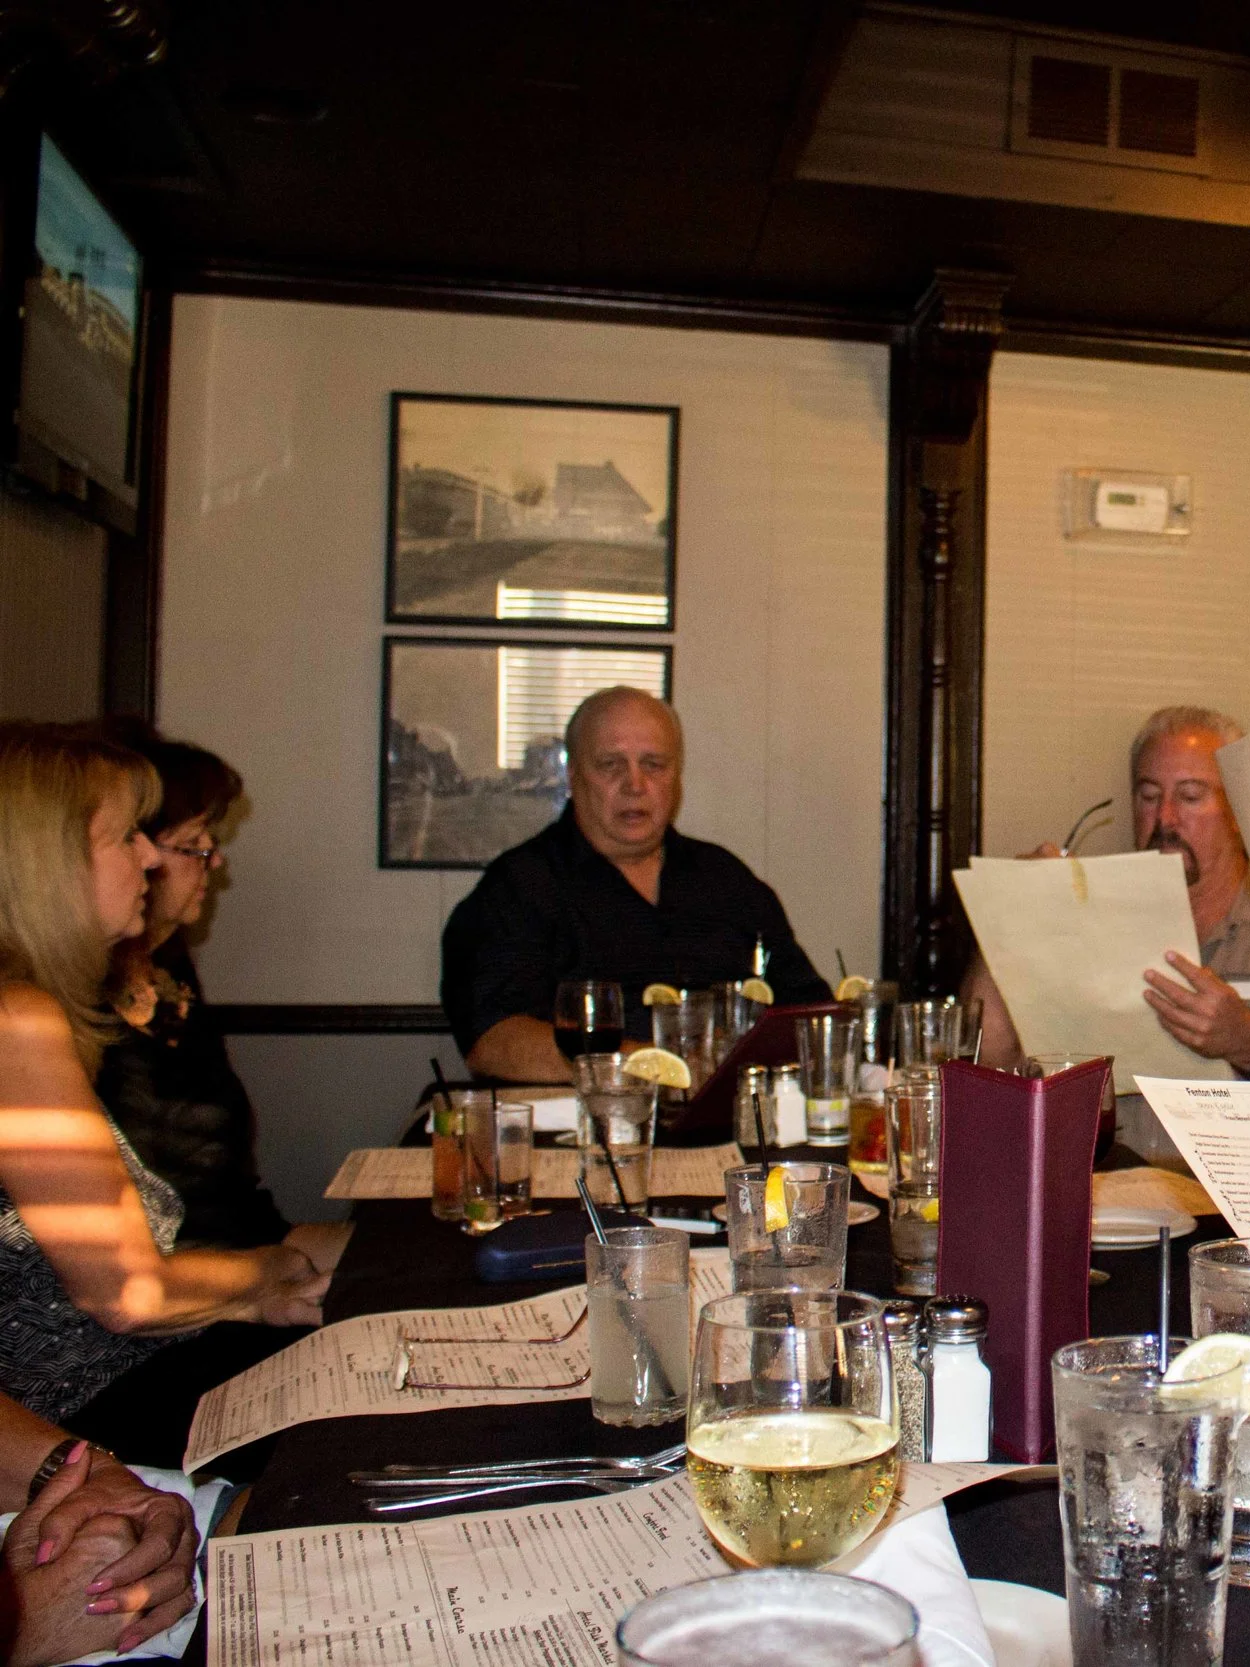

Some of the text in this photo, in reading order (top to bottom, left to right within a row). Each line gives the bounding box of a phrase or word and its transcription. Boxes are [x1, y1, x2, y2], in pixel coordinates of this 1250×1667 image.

[1185, 1087, 1231, 1098] Fenton Hotel
[446, 1586, 465, 1634] Main Course
[577, 1611, 616, 1665] Hotel Fish Market
